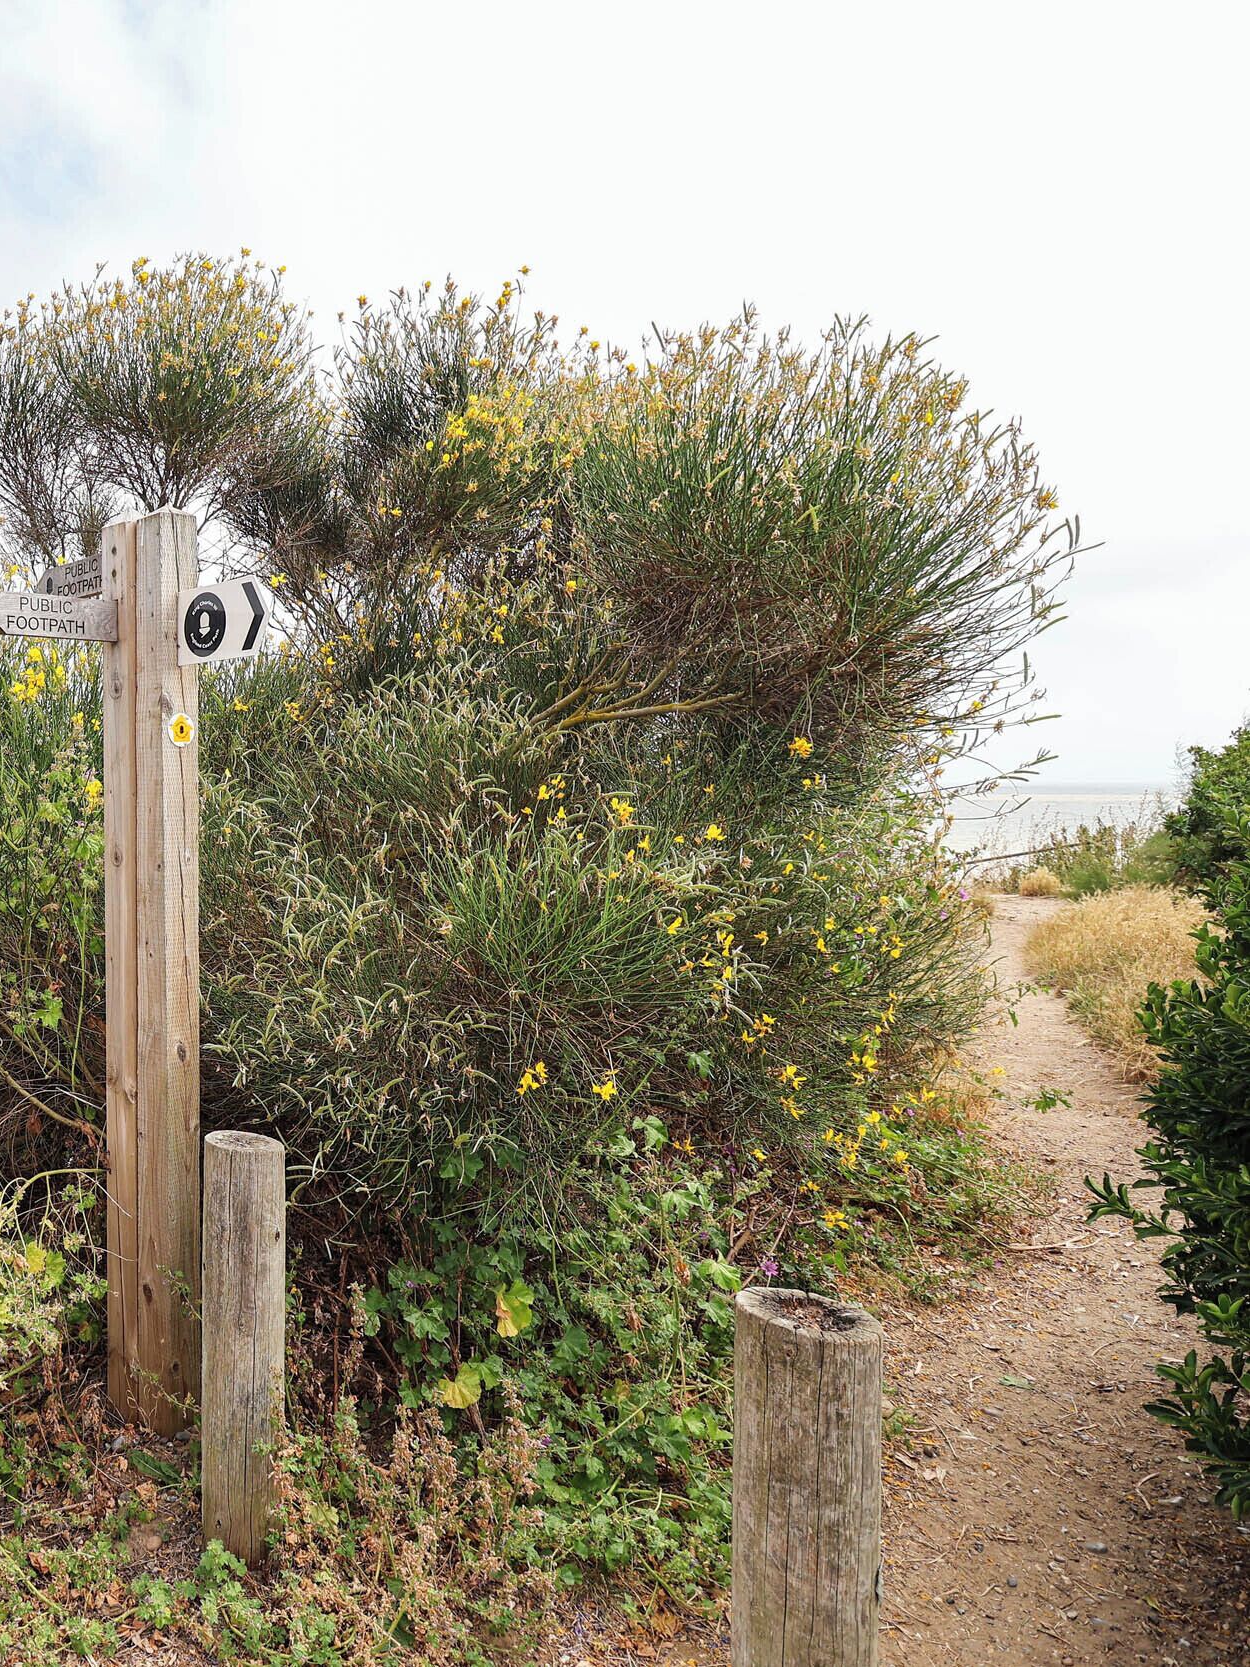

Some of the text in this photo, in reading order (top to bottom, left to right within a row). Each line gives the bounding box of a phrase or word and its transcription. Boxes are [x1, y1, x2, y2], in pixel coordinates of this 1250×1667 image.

[64, 558, 98, 579] PUBLIC
[19, 596, 73, 614] PUBLIC
[6, 615, 85, 634] FOOTPATH
